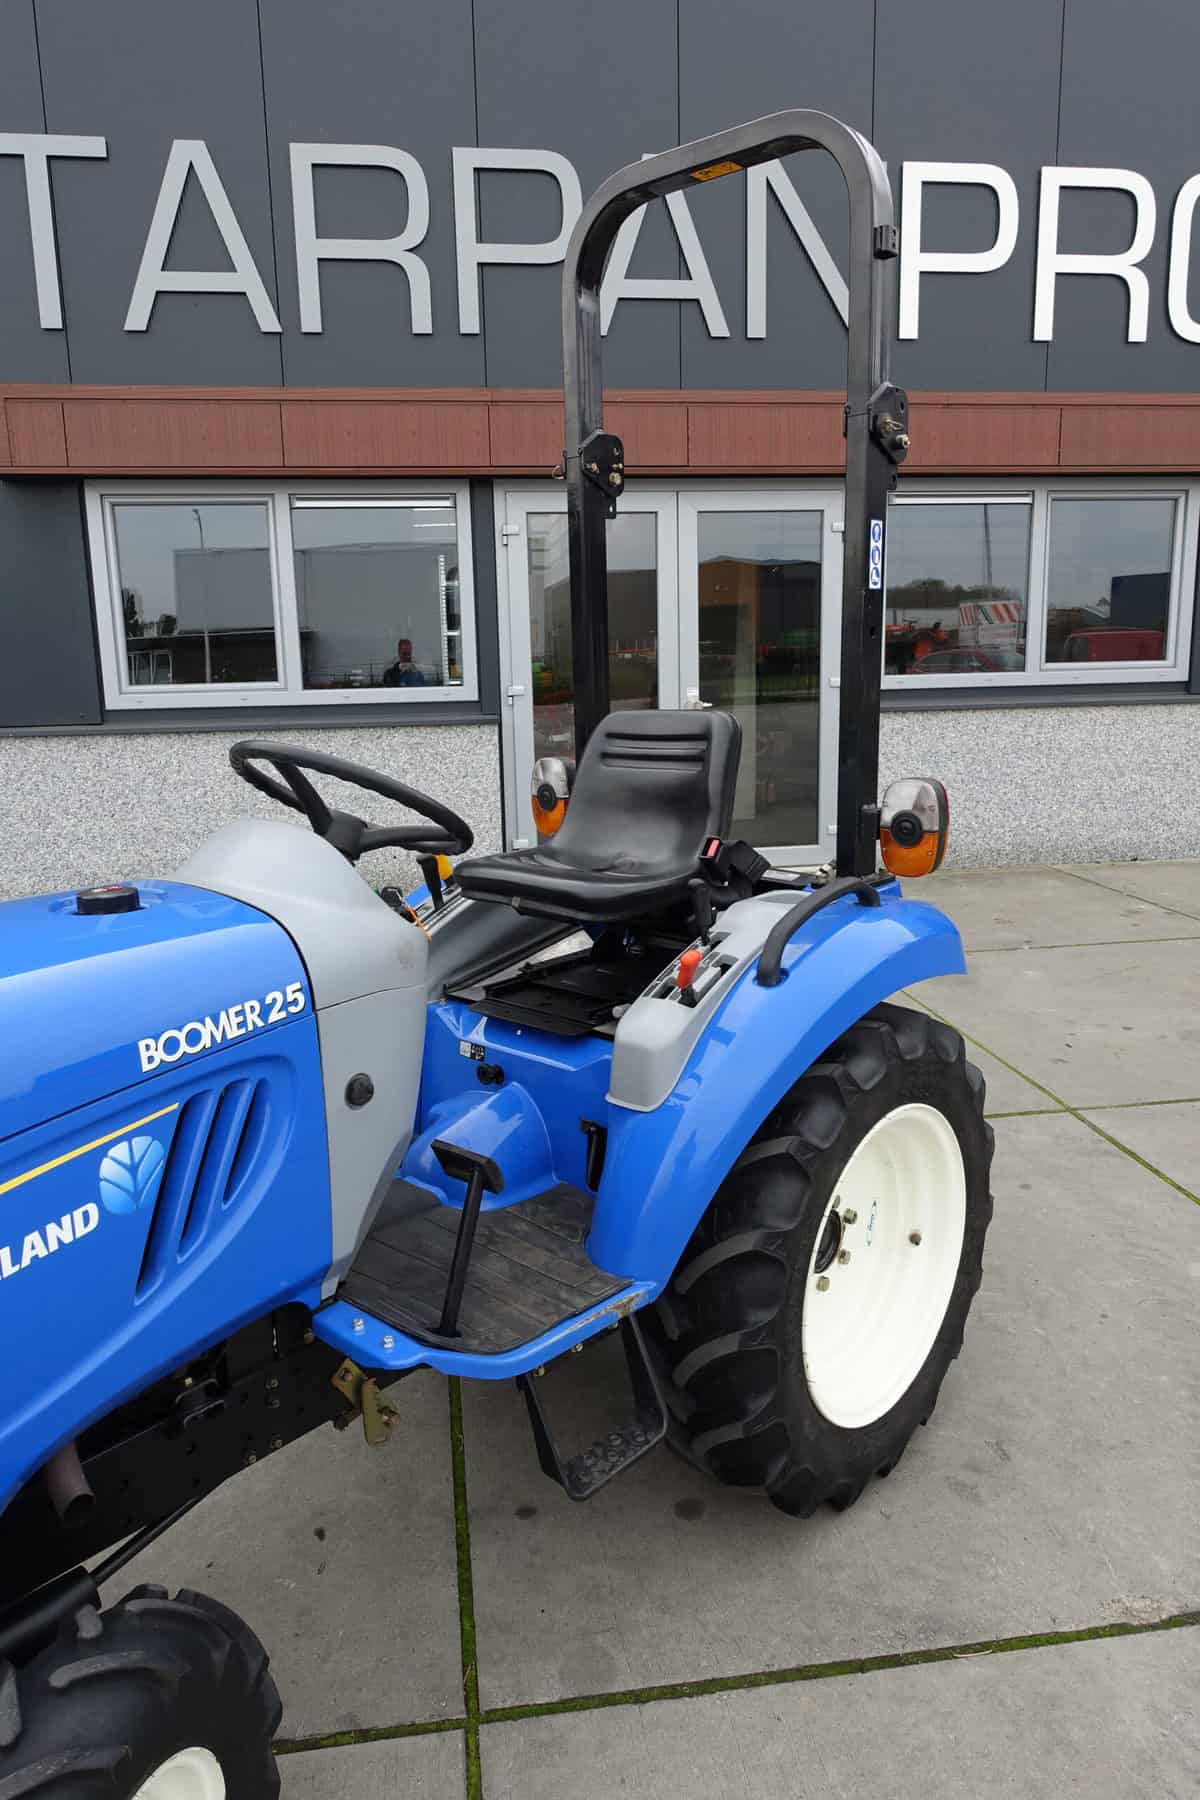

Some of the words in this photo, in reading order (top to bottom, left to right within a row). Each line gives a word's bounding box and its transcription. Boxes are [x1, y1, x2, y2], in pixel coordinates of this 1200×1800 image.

[138, 1000, 265, 1072] BOOMER
[265, 981, 306, 1023] 25
[0, 1202, 100, 1281] LAND
